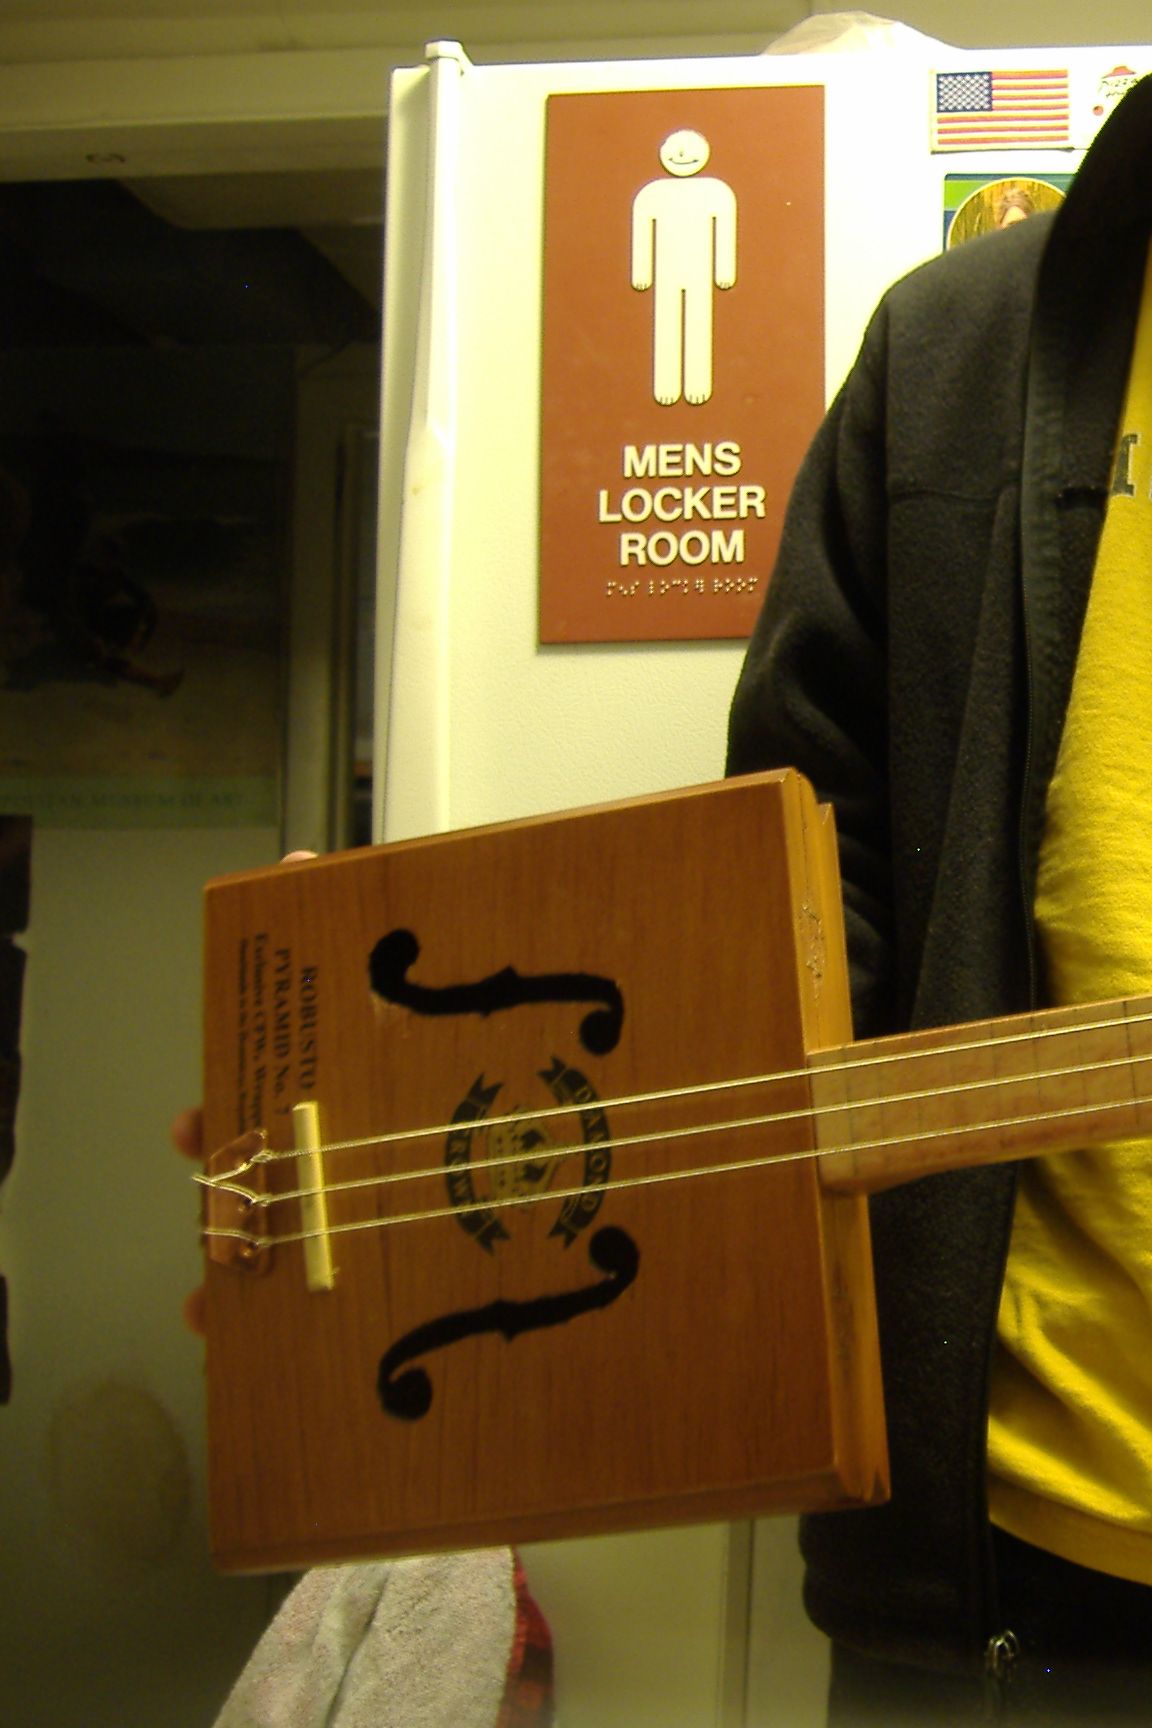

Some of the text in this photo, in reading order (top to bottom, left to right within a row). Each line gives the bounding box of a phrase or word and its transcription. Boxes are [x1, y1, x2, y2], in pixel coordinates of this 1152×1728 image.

[623, 441, 742, 478] MENS
[598, 485, 767, 523] LOCKER
[620, 530, 745, 566] ROOM
[274, 948, 290, 1059] PYRAMID
[300, 965, 318, 1089] ROBUSTO
